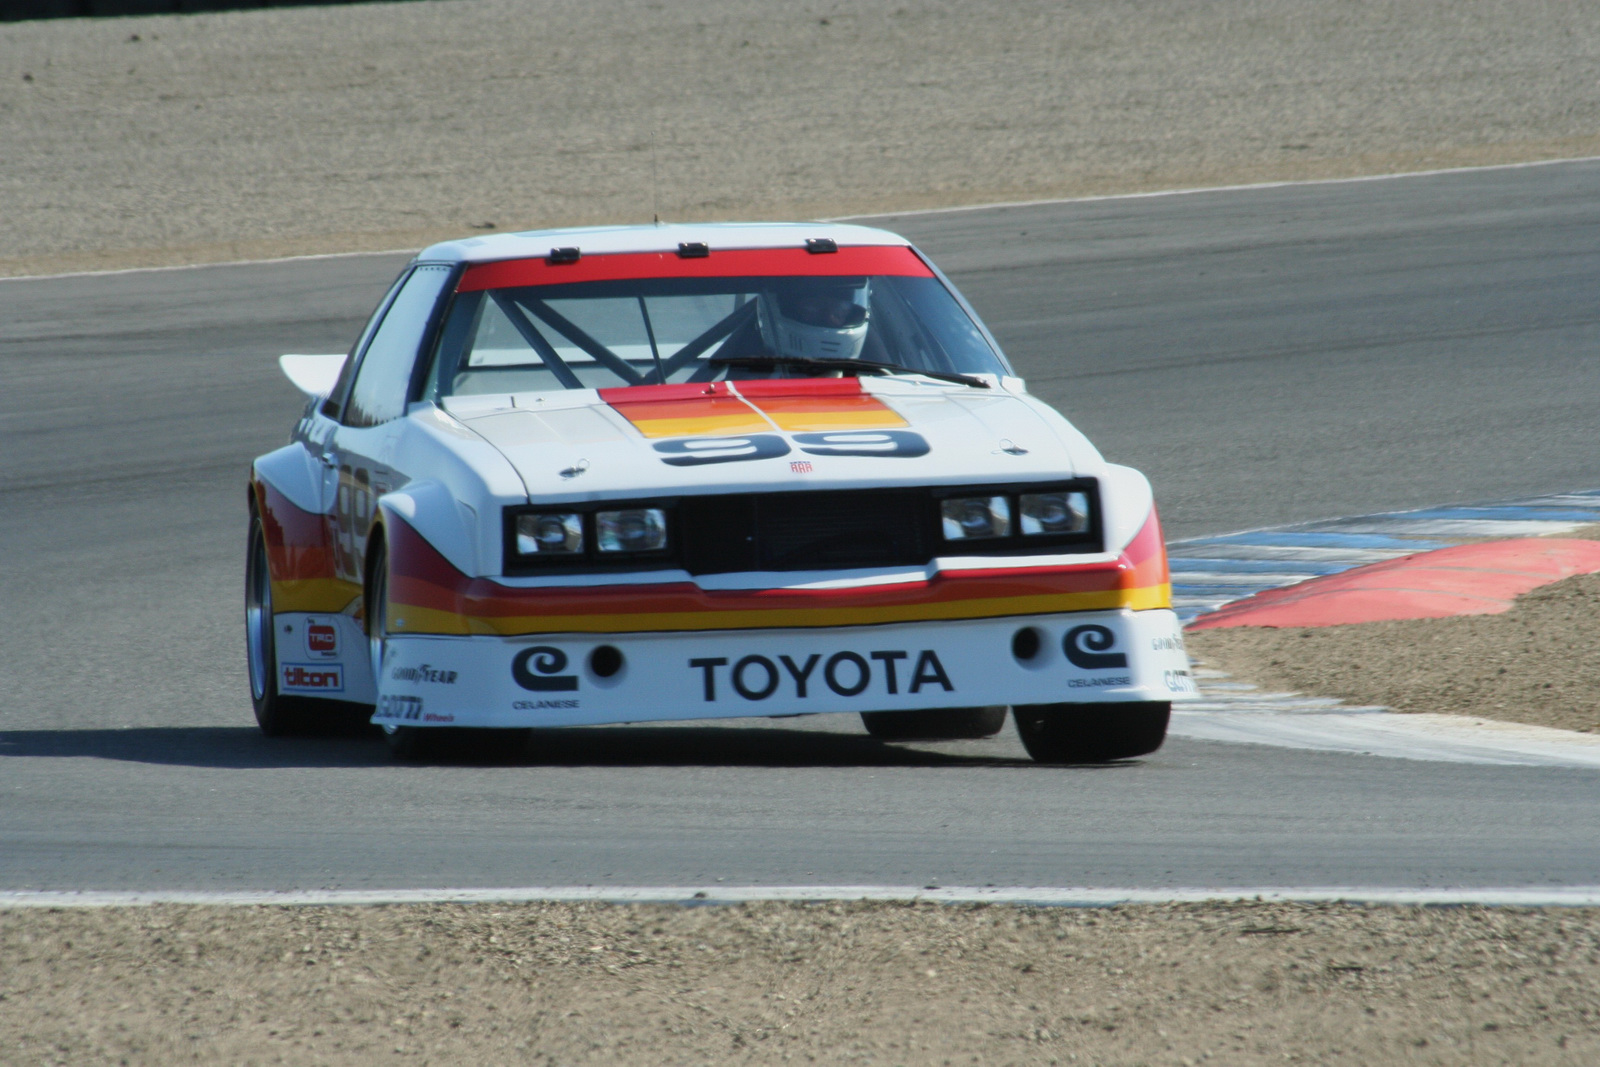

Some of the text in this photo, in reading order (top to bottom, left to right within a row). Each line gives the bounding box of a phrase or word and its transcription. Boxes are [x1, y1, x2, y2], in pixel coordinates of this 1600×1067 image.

[653, 430, 931, 467] 99
[284, 667, 339, 687] tilton
[689, 649, 955, 702] TOYOTA
[1067, 676, 1131, 688] CELANESE
[513, 698, 580, 711] CELANESE
